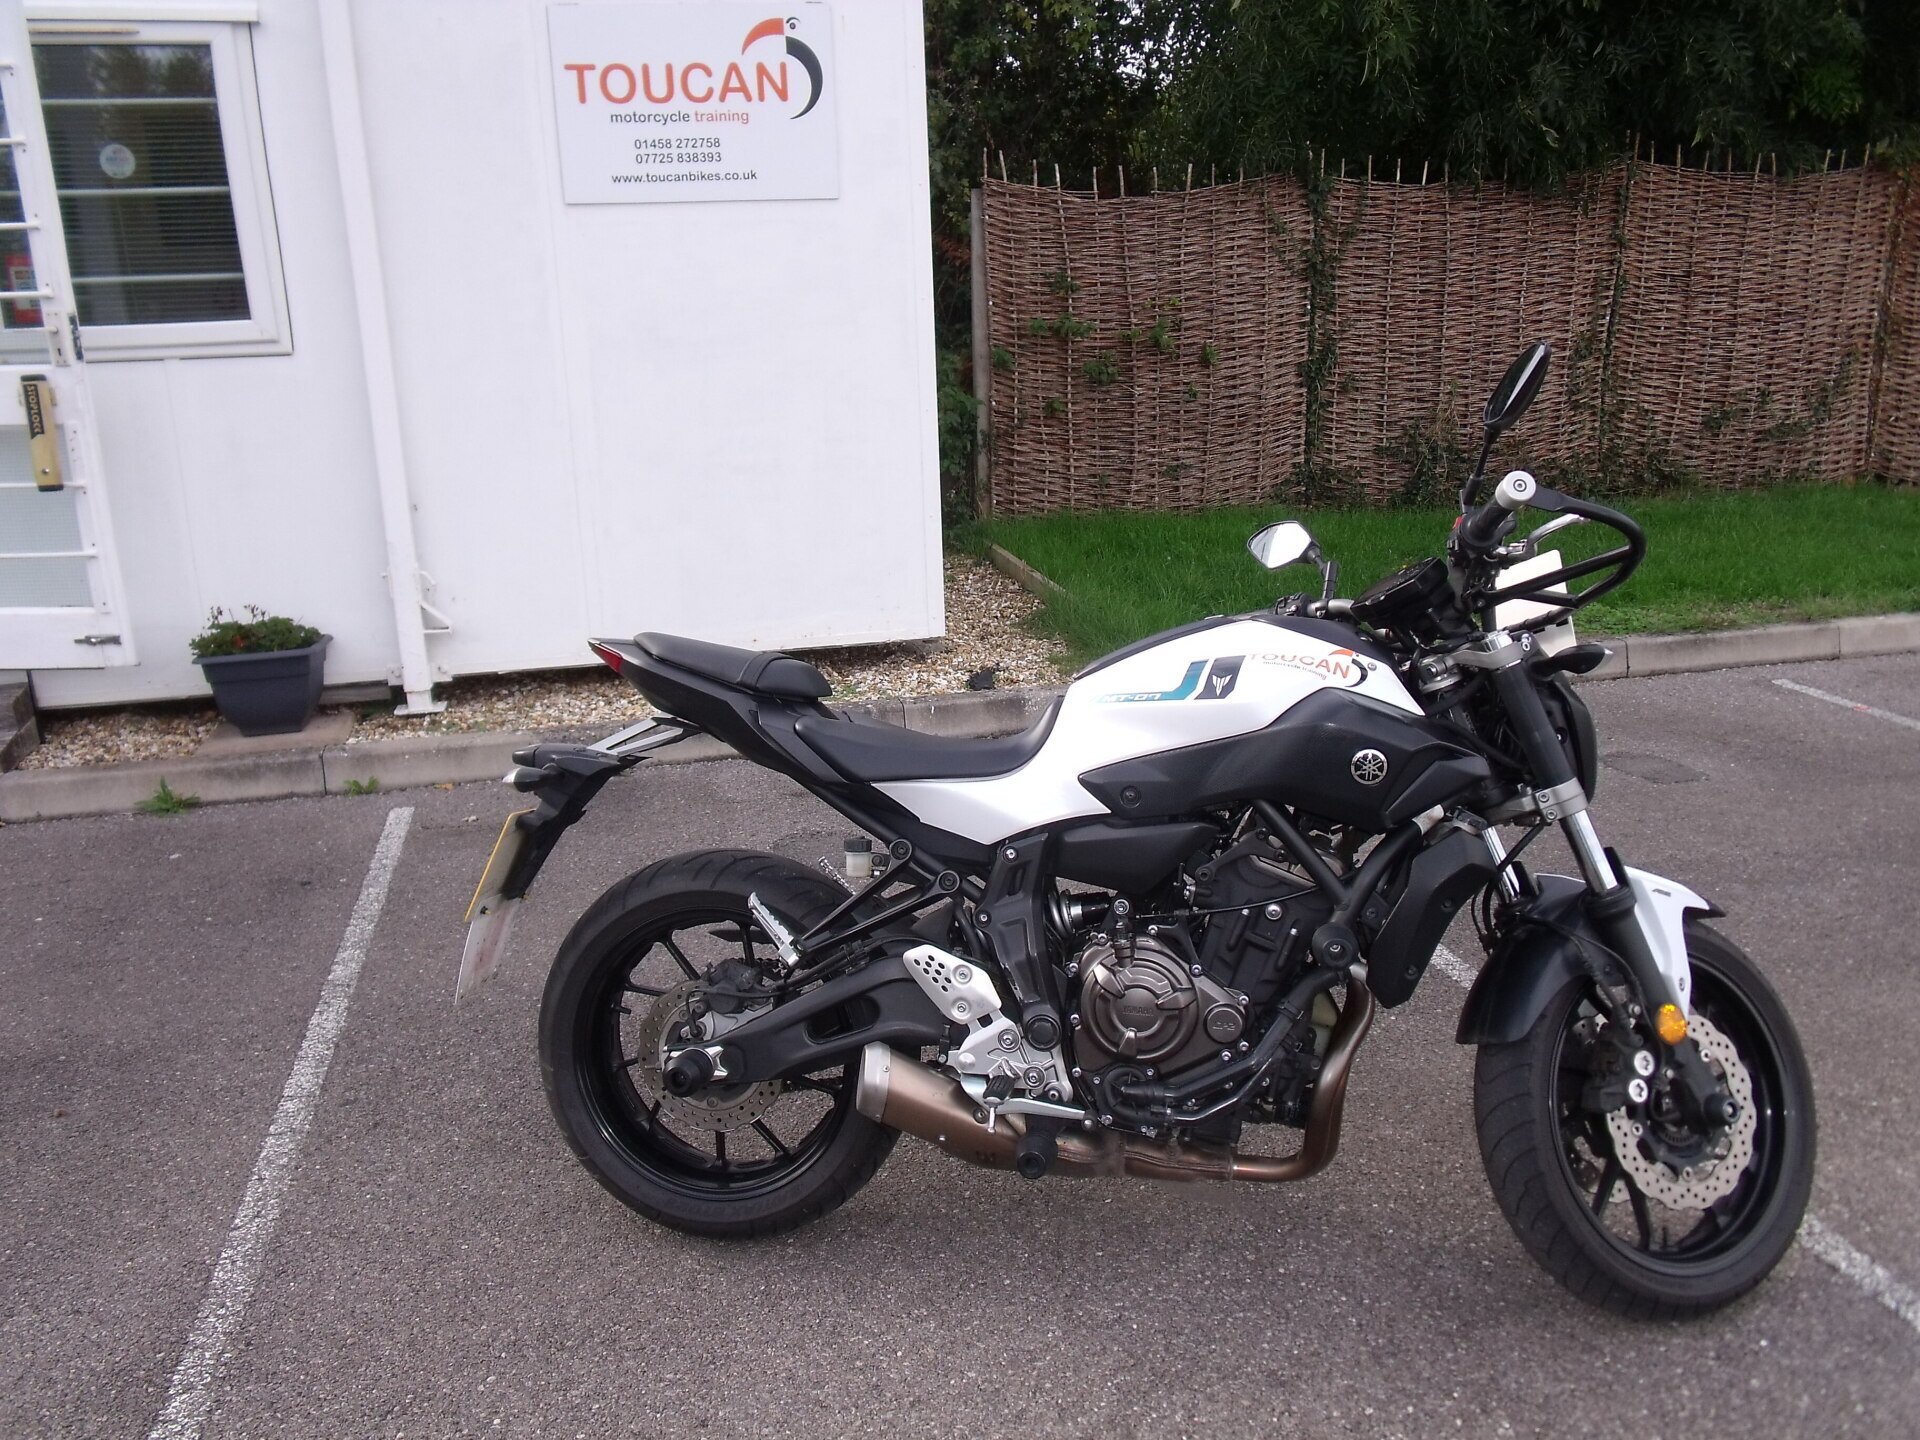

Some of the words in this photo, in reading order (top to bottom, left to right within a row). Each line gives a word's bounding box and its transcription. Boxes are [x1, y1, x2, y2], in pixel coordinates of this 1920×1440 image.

[564, 61, 789, 105] TOUCAN
[610, 110, 691, 126] motorcycle
[694, 109, 749, 125] training
[634, 138, 673, 150] 01458
[675, 137, 721, 149] 272758
[635, 152, 674, 164] 07725
[676, 151, 722, 163] 838393
[611, 169, 758, 184] www.toucanbikes.co.uk
[27, 384, 42, 434] STOPLOCK
[1249, 653, 1350, 679] TOUCAN
